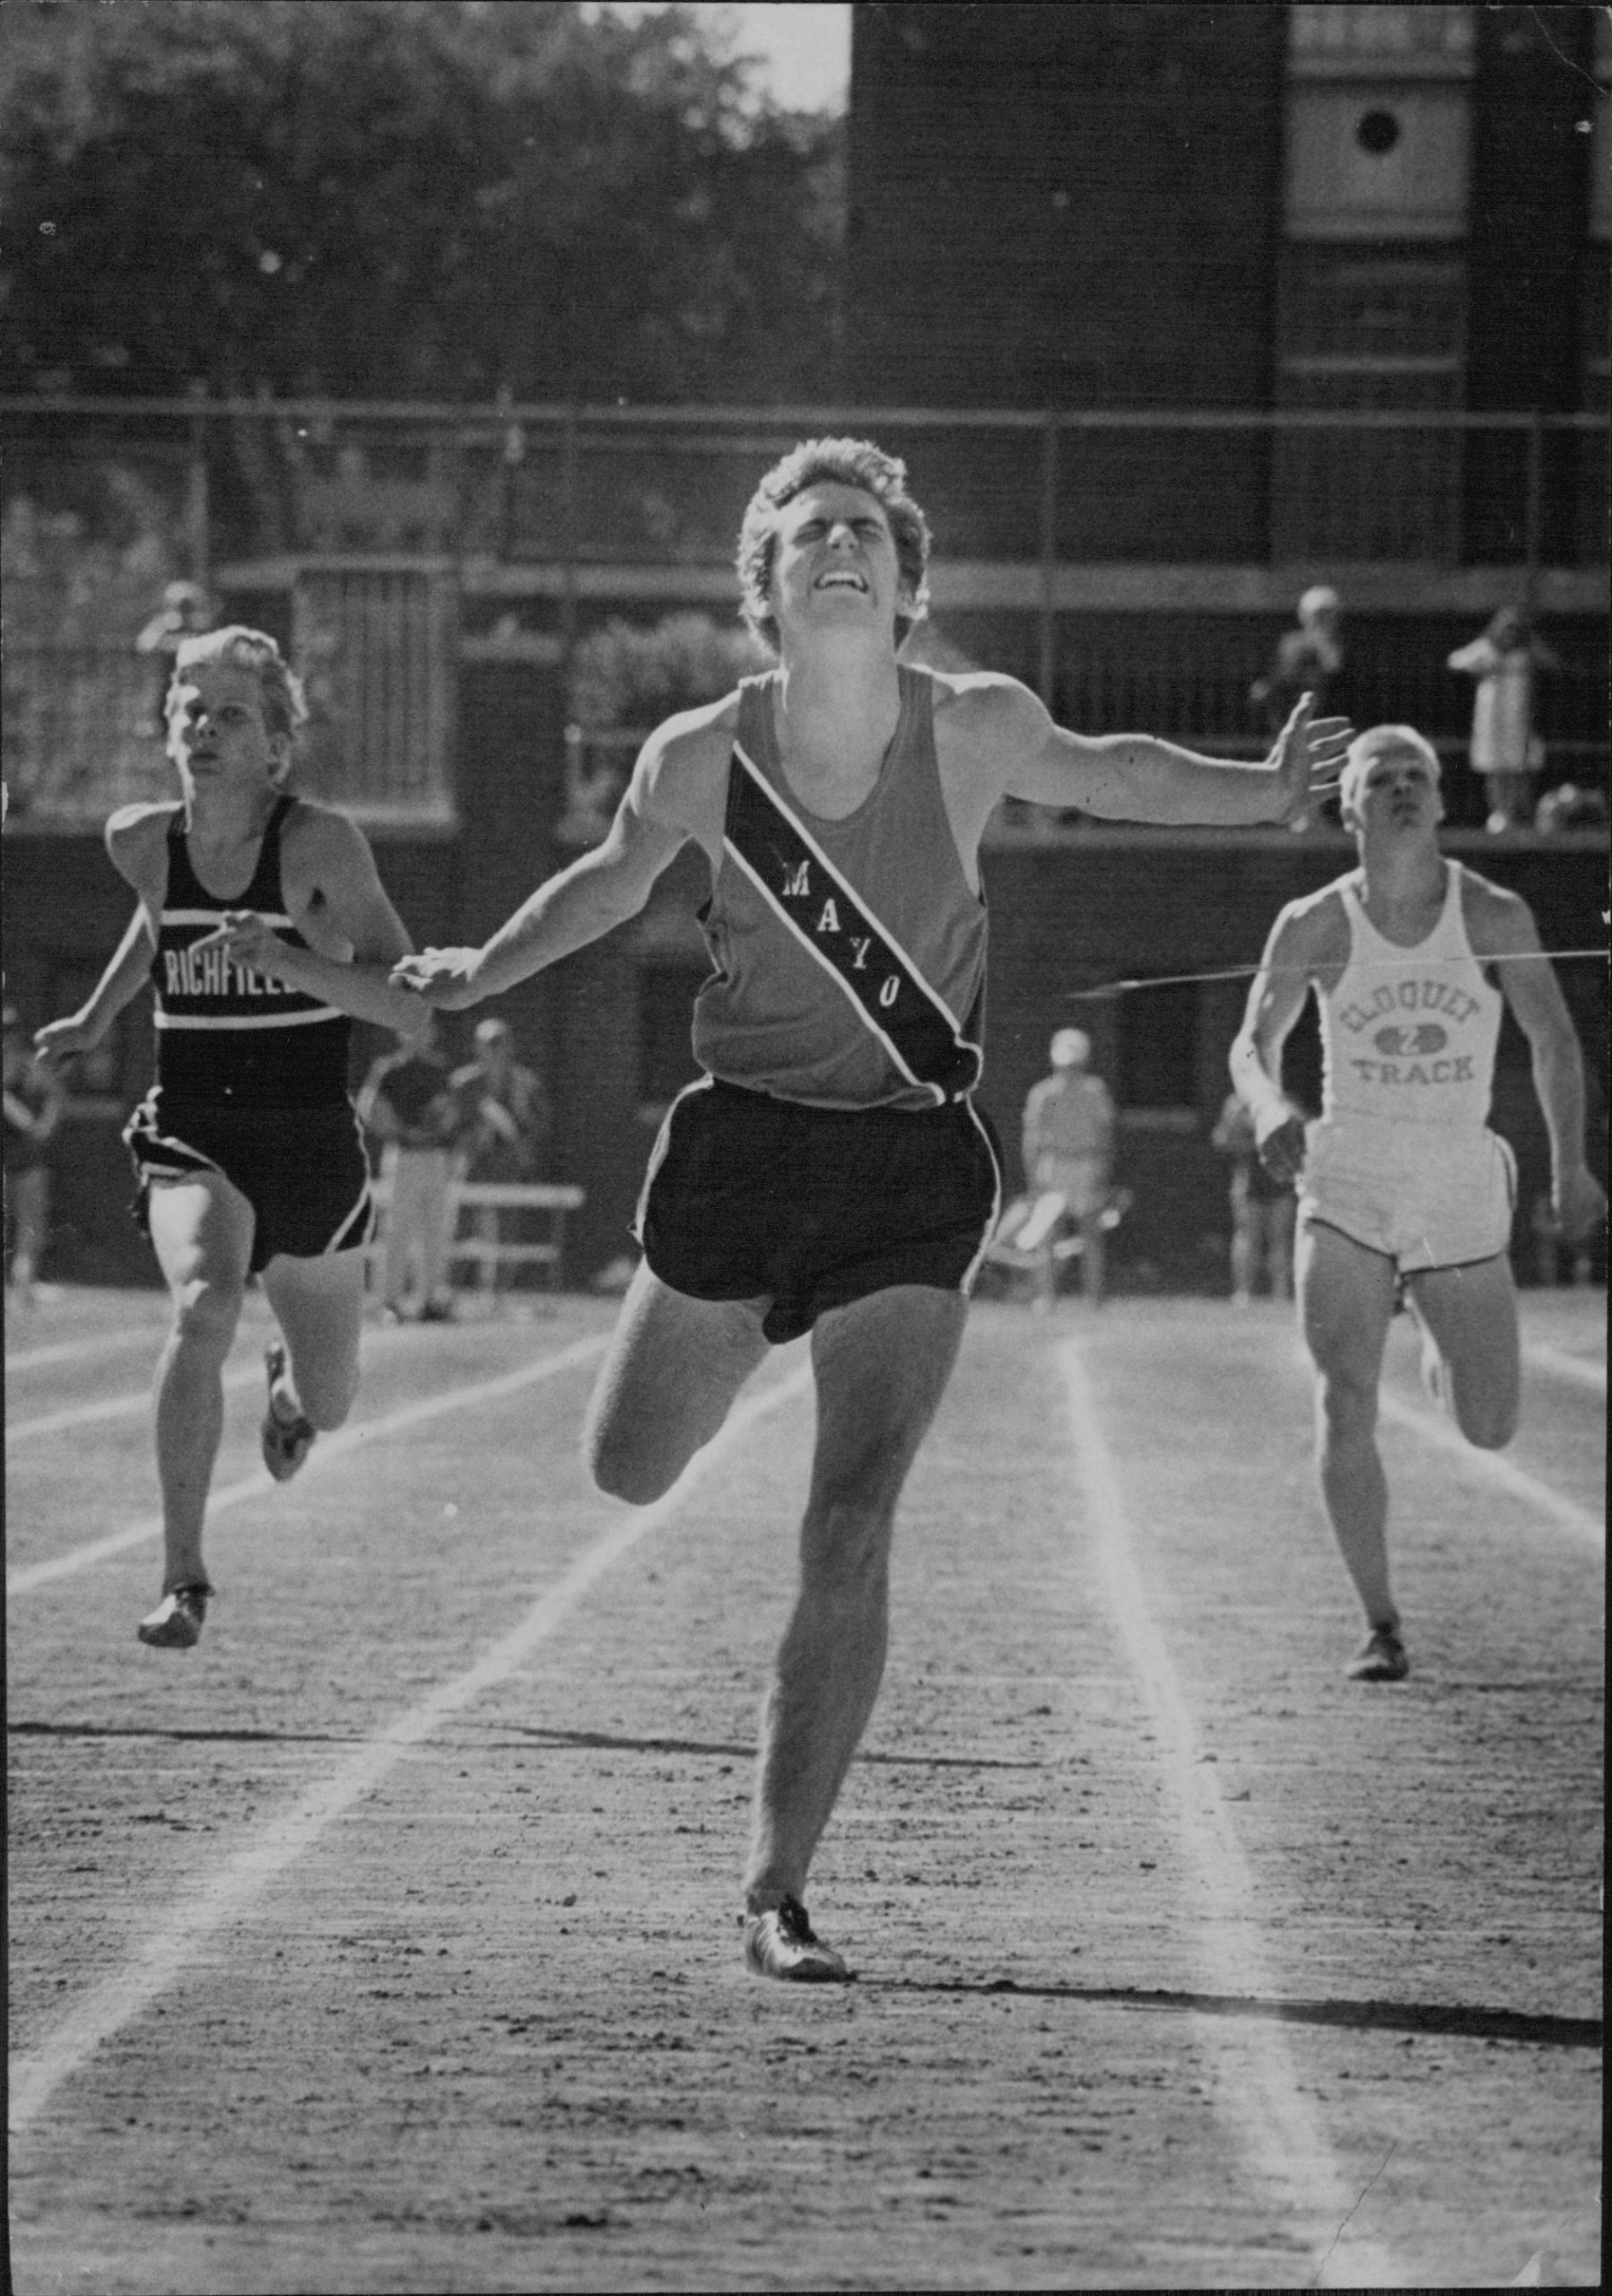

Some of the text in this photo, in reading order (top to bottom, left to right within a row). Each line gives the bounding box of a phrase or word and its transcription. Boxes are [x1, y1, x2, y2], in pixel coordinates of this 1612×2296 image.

[782, 860, 901, 1007] MAYO
[164, 944, 297, 996] RICHFIE
[1339, 981, 1480, 1033] CLOQUET
[1351, 1056, 1474, 1085] TRACK
